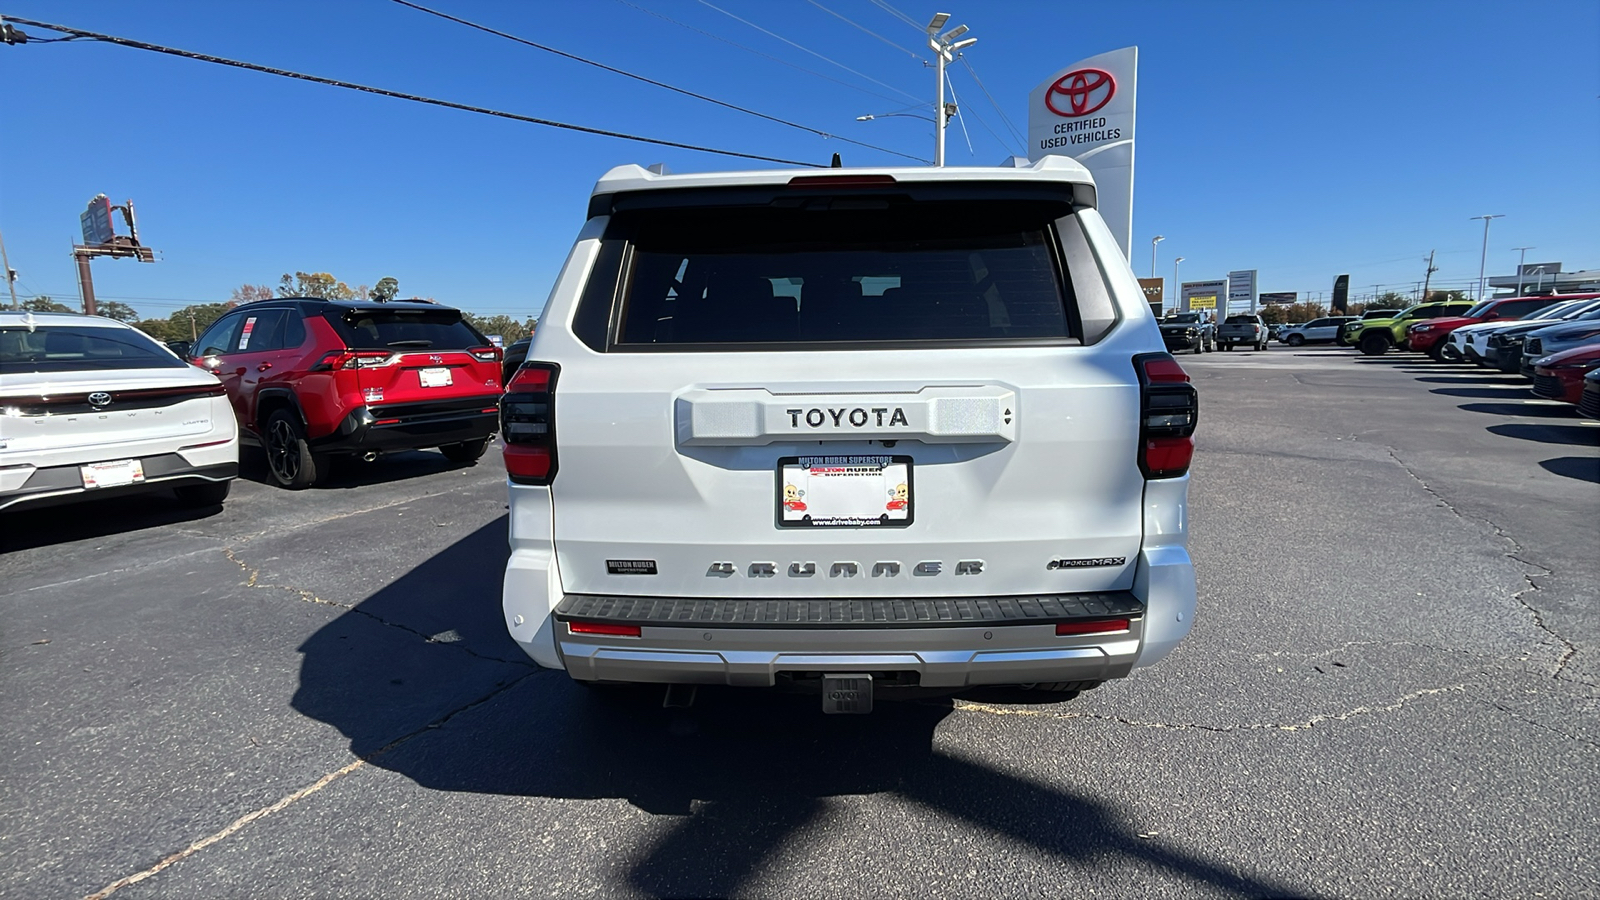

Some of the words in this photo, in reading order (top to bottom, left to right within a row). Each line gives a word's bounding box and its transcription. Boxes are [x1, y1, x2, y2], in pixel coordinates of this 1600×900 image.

[1054, 117, 1106, 134] CERTIFIED
[1040, 137, 1067, 149] USED
[1070, 128, 1121, 144] VEHICLES
[34, 410, 163, 424] CROWN
[786, 408, 909, 428] TOYOTA
[848, 456, 893, 464] SUPERSTORE
[706, 560, 985, 578] 4RUNNER
